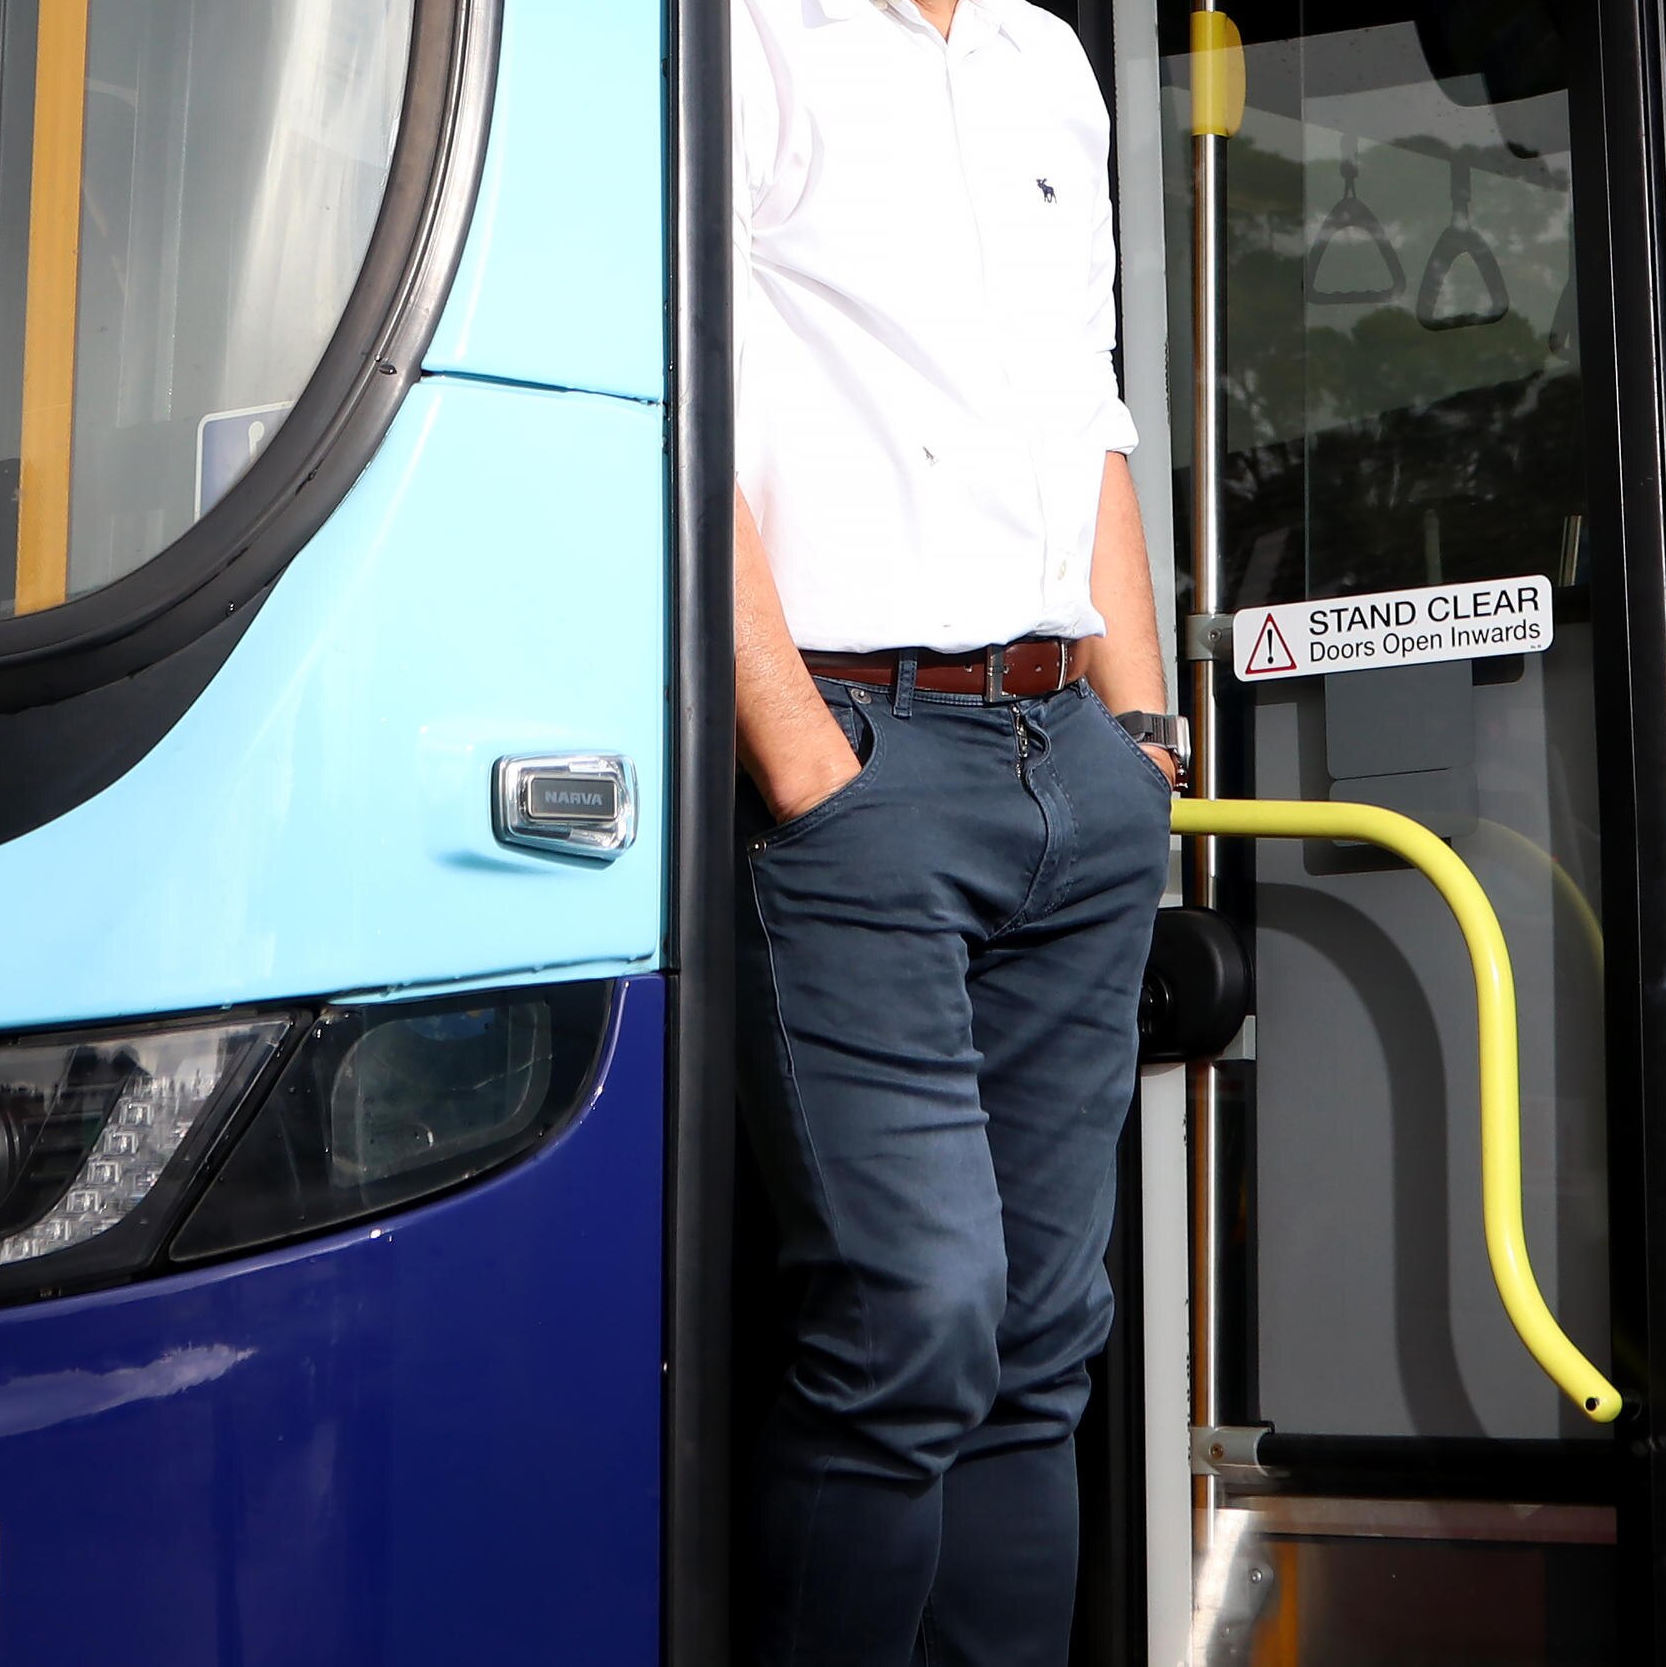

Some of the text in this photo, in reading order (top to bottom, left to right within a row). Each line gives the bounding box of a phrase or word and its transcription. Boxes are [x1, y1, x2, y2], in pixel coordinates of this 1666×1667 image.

[1308, 586, 1540, 636] STAND CLEAR
[1310, 619, 1541, 663] Doors Open Inwards
[544, 790, 603, 806] NARVA
